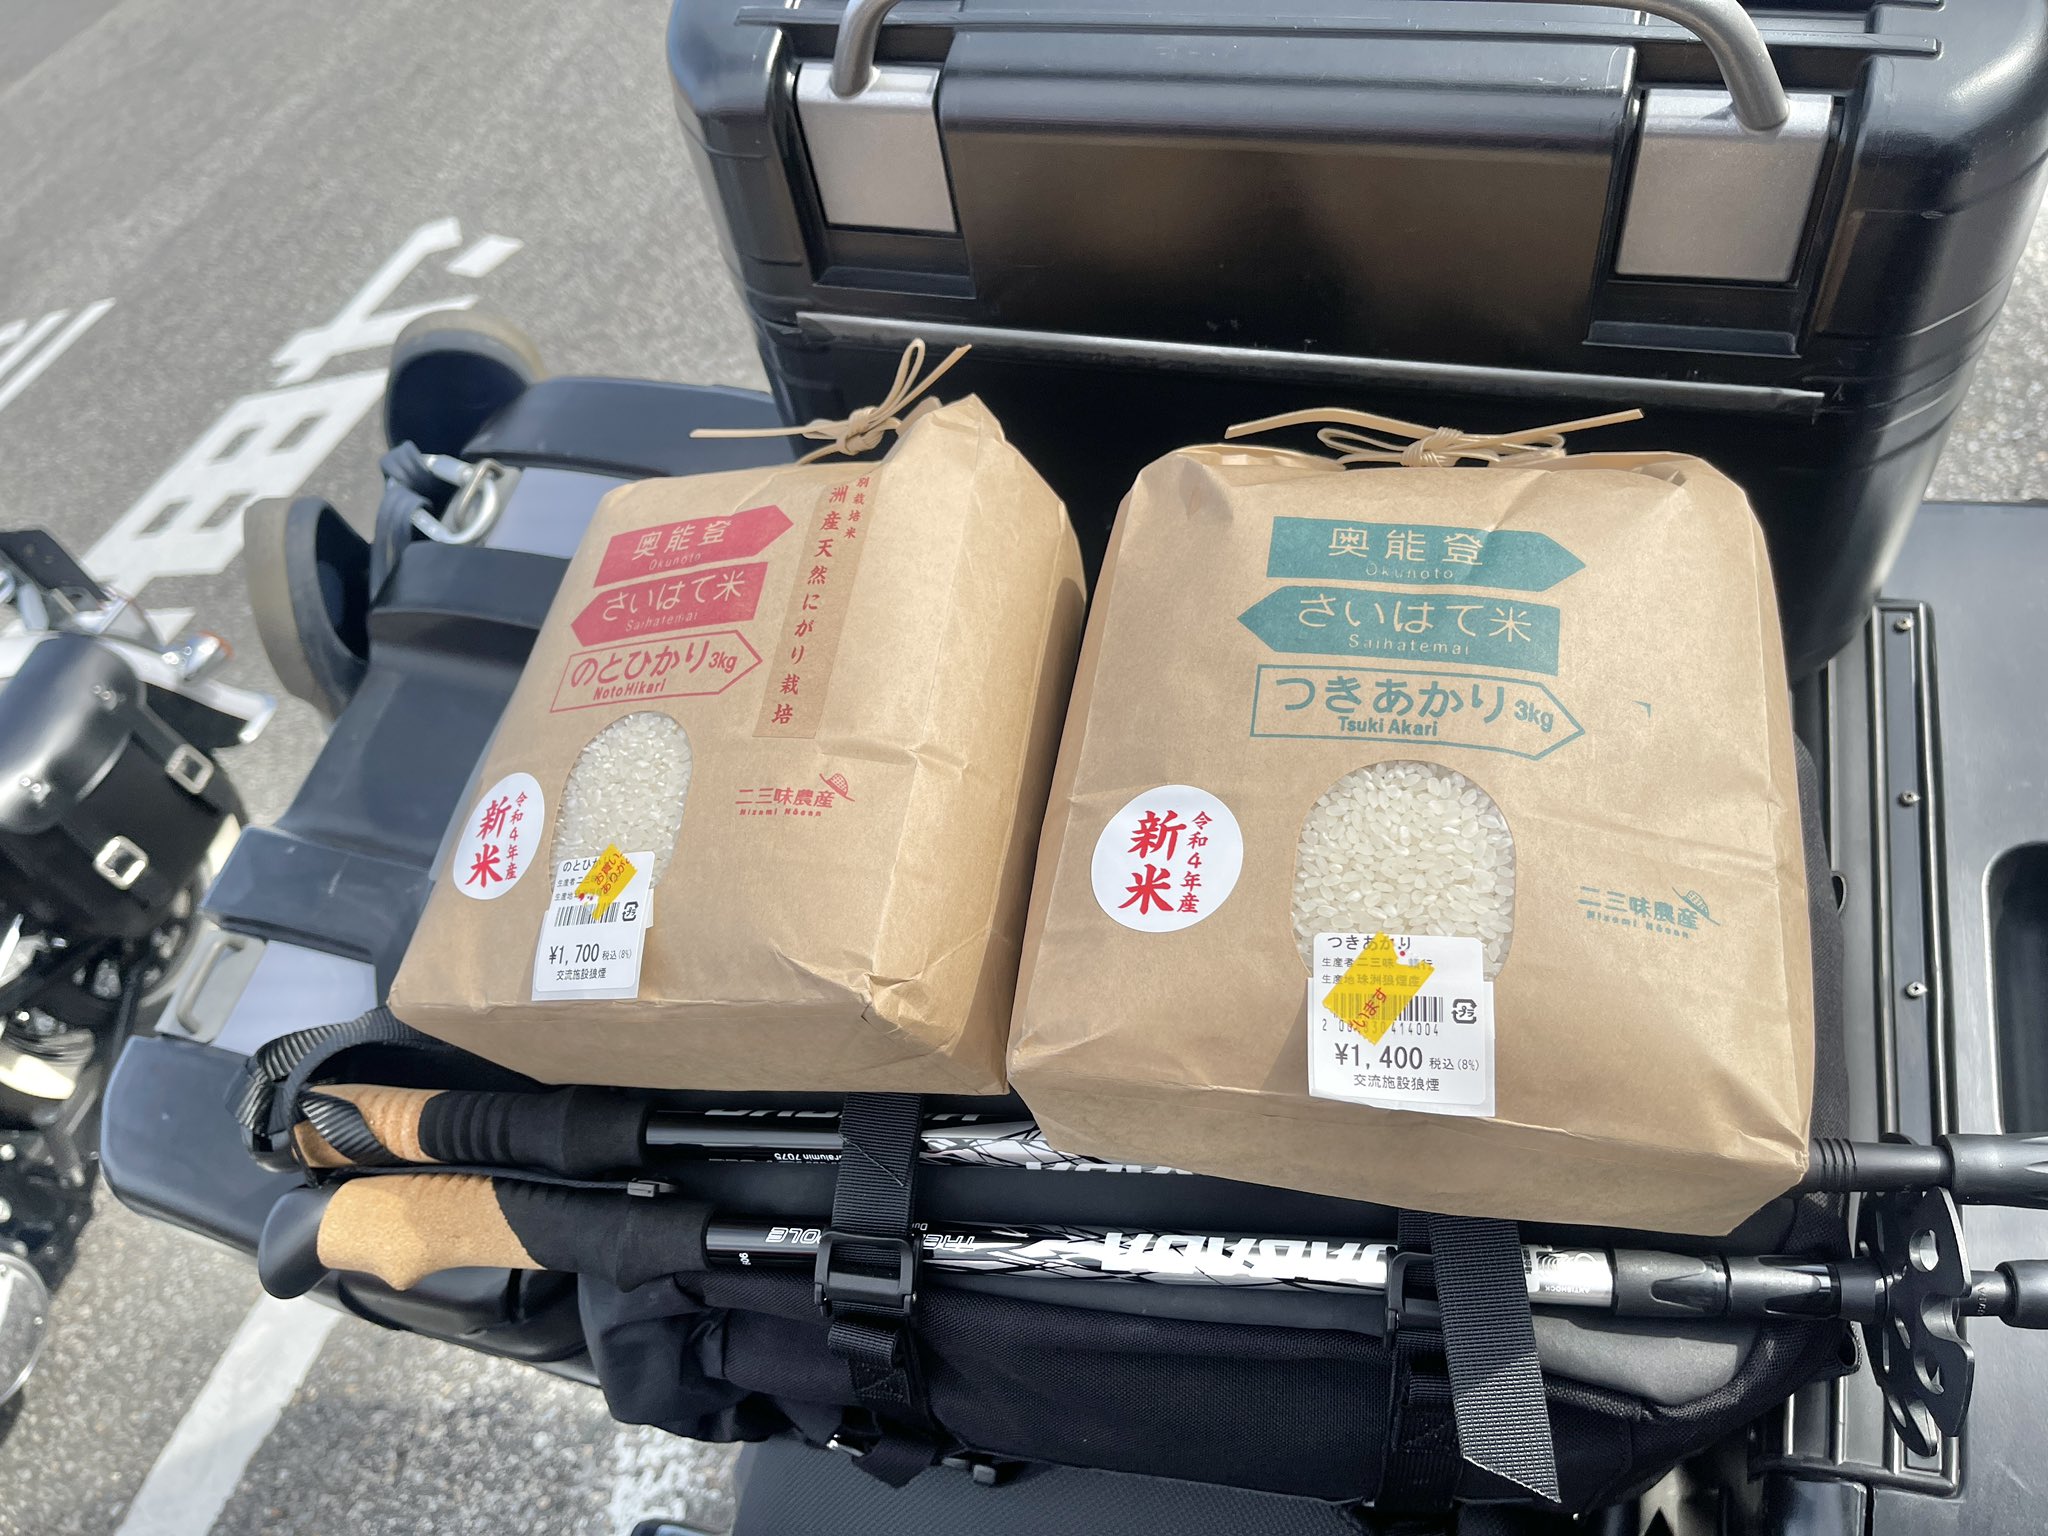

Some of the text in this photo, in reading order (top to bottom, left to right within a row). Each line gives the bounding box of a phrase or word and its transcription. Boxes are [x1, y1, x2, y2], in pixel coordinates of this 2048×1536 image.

[632, 519, 732, 561] 奥能登
[648, 553, 702, 571] Okunoto
[1327, 526, 1485, 566] 奥能登
[1364, 564, 1455, 580] Okunoto
[602, 568, 747, 622] さいはて米
[1297, 593, 1532, 642] さいはて米
[625, 612, 699, 633] Saihatemai
[1347, 633, 1471, 656] Saihatemai
[570, 639, 738, 689] のとひかり 3kg
[1275, 675, 1555, 734] つきあかり 3kg
[1337, 716, 1439, 737] Tsuki Akari
[464, 795, 513, 889] 新米
[504, 791, 529, 881] 令和4年産
[1117, 809, 1188, 916] 新米
[1176, 810, 1214, 914] 令和4年産
[1334, 1042, 1424, 1070] ¥1,400
